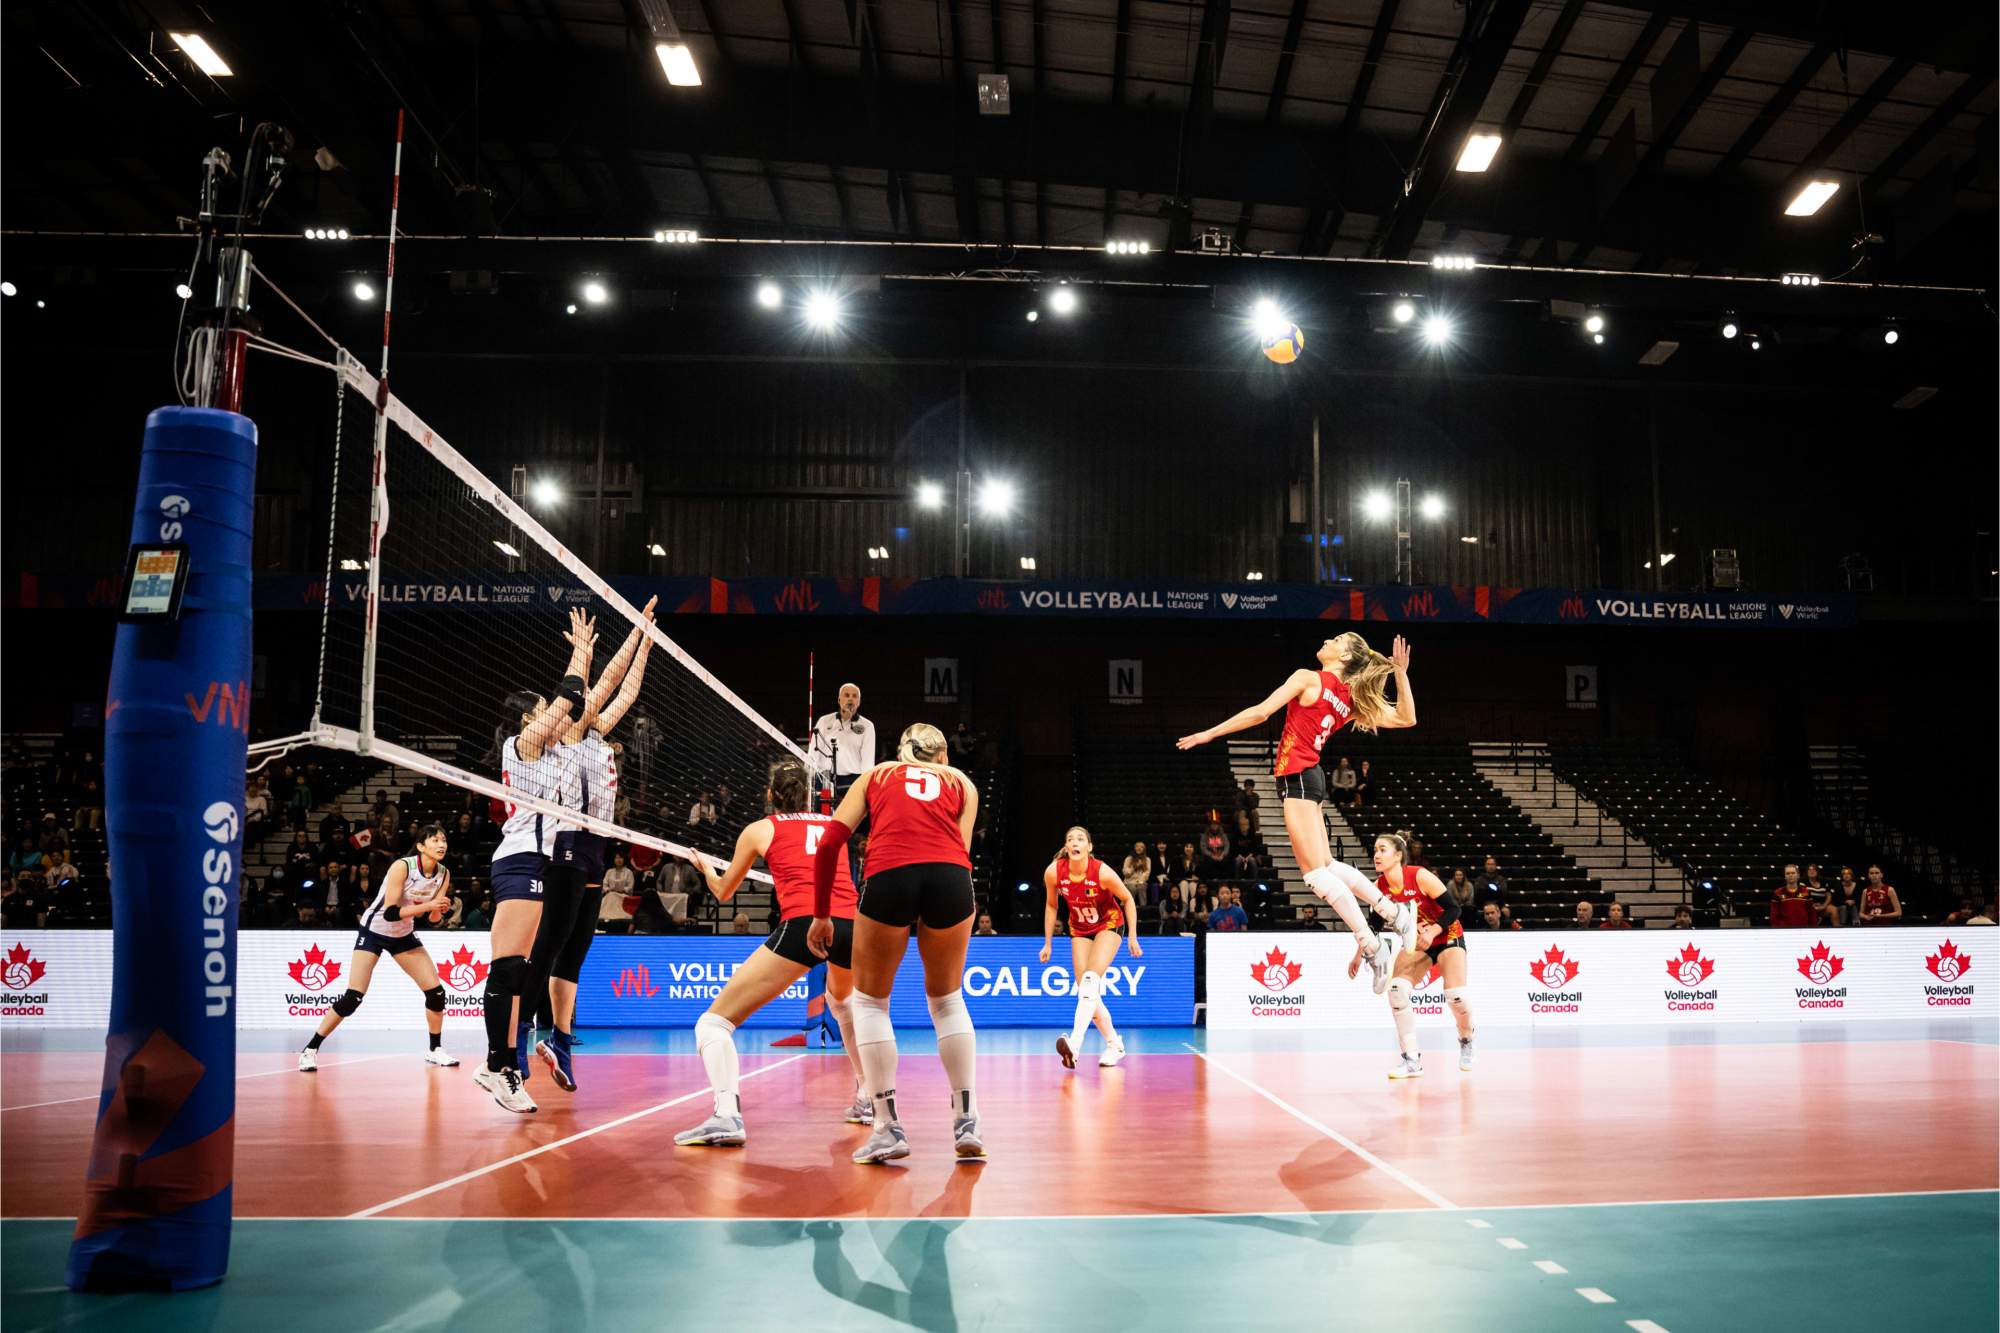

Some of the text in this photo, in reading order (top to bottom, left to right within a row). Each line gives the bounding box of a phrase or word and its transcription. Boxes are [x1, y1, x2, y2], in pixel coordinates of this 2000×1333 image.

[493, 585, 536, 594] NATIONS
[492, 594, 530, 603] LEAGUE
[775, 580, 821, 612] VNL
[1020, 590, 1163, 609] VOLLEYBALL
[1167, 591, 1209, 600] NATIONS
[1240, 594, 1278, 603] Volleyball
[1167, 601, 1204, 610] LEAGUE
[1240, 602, 1266, 610] World
[1402, 590, 1440, 617] VNL
[1596, 599, 1726, 619] VOLLEYBALL
[1729, 603, 1767, 611] NATIONS
[1729, 611, 1763, 620] LEAGUE
[930, 667, 952, 696] M
[1117, 667, 1134, 695] N
[1575, 675, 1589, 702] P
[1313, 713, 1336, 752] 3
[905, 766, 941, 802] 5
[530, 879, 543, 893] 30
[1073, 906, 1099, 924] 19
[202, 848, 232, 1017] Senoh
[611, 963, 660, 997] VNL
[669, 985, 724, 999] NATIO
[1665, 989, 1717, 1001] Volleyball
[1795, 987, 1847, 999] Volleyball
[1924, 985, 1974, 996] Volleyball
[0, 993, 48, 1006] lleyball
[1249, 994, 1305, 1006] Volleyball
[1528, 992, 1582, 1003] Volleyball
[1798, 998, 1844, 1008] Canada
[1927, 995, 1971, 1006] Canada
[0, 1005, 44, 1015] anada
[288, 1005, 331, 1016] Cana
[1252, 1005, 1301, 1016] Canada
[1412, 1004, 1443, 1015] nada
[1531, 1002, 1579, 1013] Canada
[1668, 1000, 1714, 1011] Canada
